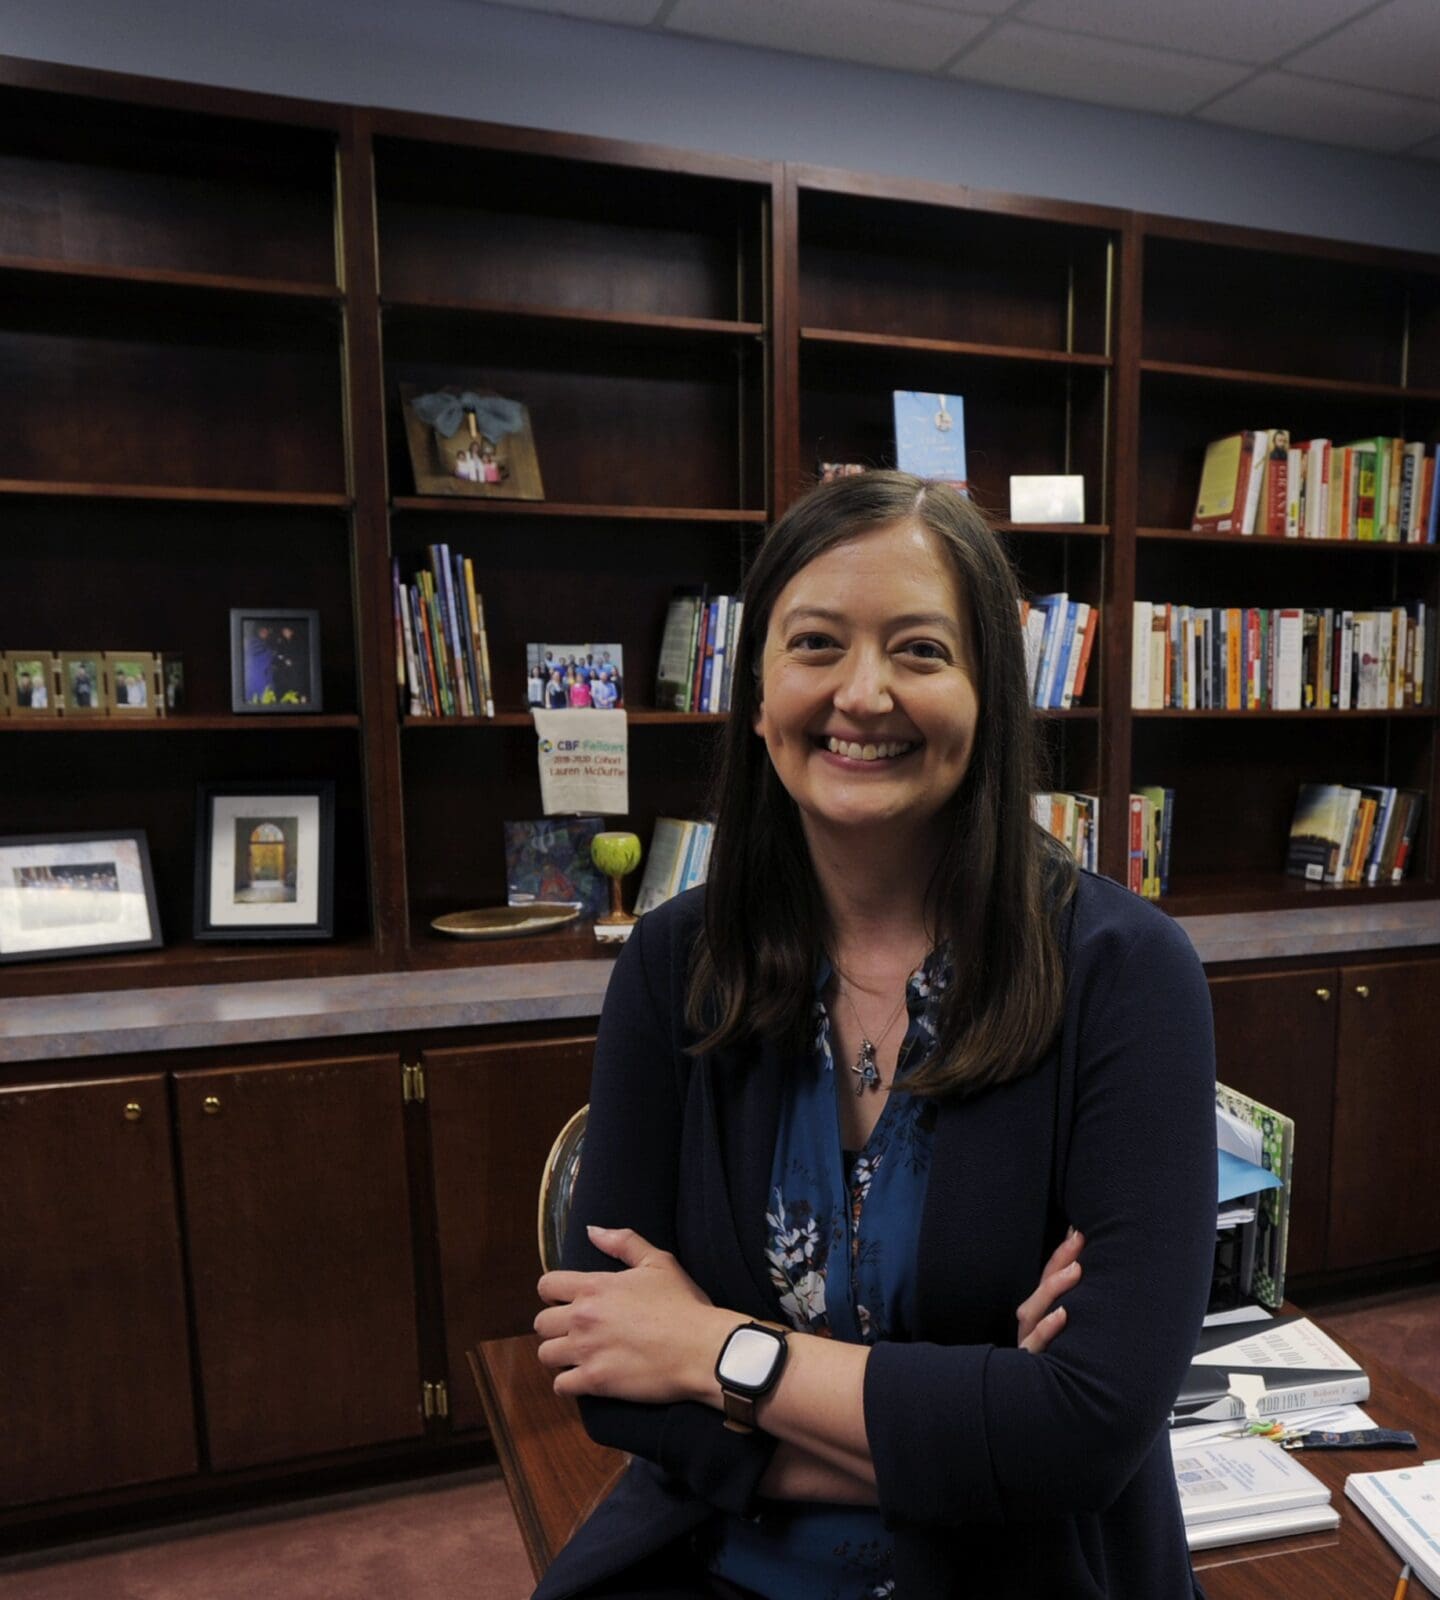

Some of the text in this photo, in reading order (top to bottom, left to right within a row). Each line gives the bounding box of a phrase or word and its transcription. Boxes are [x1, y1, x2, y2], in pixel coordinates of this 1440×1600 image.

[1277, 465, 1287, 519] GRANT
[557, 740, 625, 752] CBF Fellows
[594, 757, 621, 765] Cohort
[550, 766, 580, 777] Lauren
